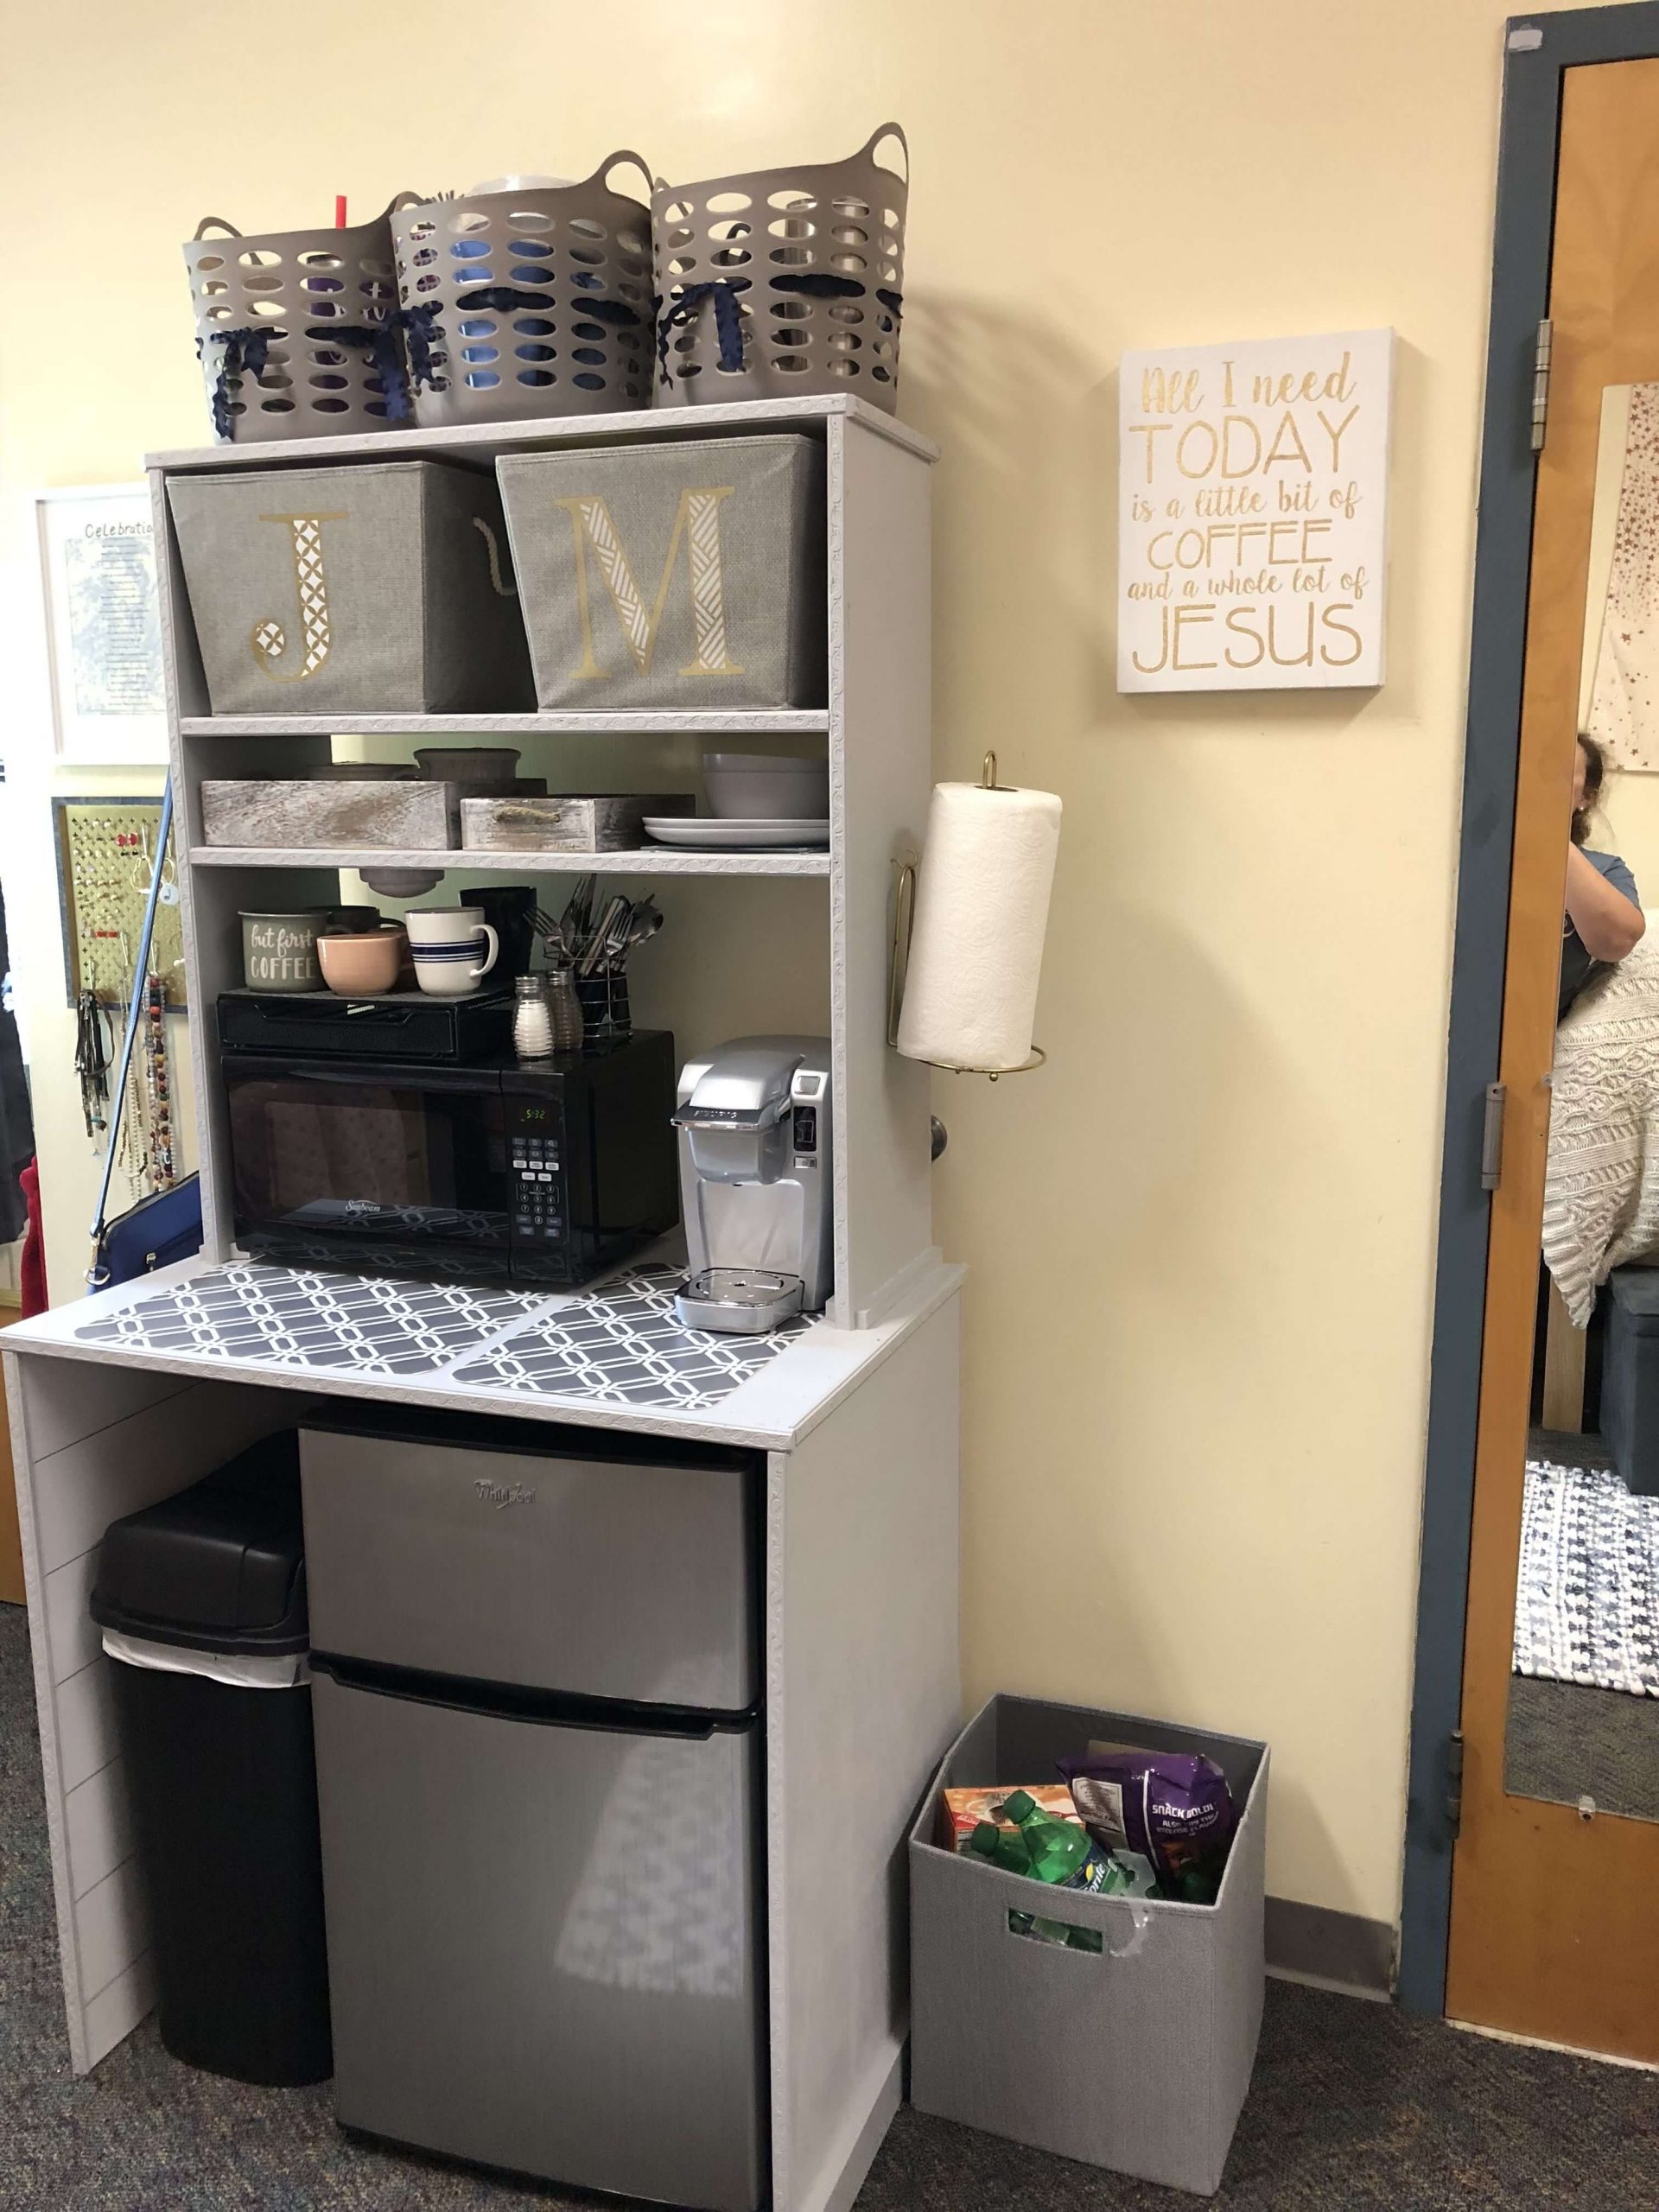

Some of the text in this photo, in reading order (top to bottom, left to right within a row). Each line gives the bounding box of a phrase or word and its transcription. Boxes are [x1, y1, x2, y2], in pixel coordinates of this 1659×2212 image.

[1141, 351, 1357, 414] All I need
[1128, 404, 1360, 484] TODAY
[1132, 480, 1362, 522] is a little bit of
[1147, 518, 1332, 570] COFFEE
[253, 512, 348, 683] J
[553, 486, 744, 679] M
[1128, 565, 1370, 600] and a whole lot of
[1132, 601, 1362, 673] JESUS
[251, 924, 314, 957] but first
[251, 956, 315, 980] COFFEE
[526, 1109, 545, 1120] 5:32
[346, 1199, 380, 1211] Sunbeam
[474, 1479, 536, 1510] Whirlpool
